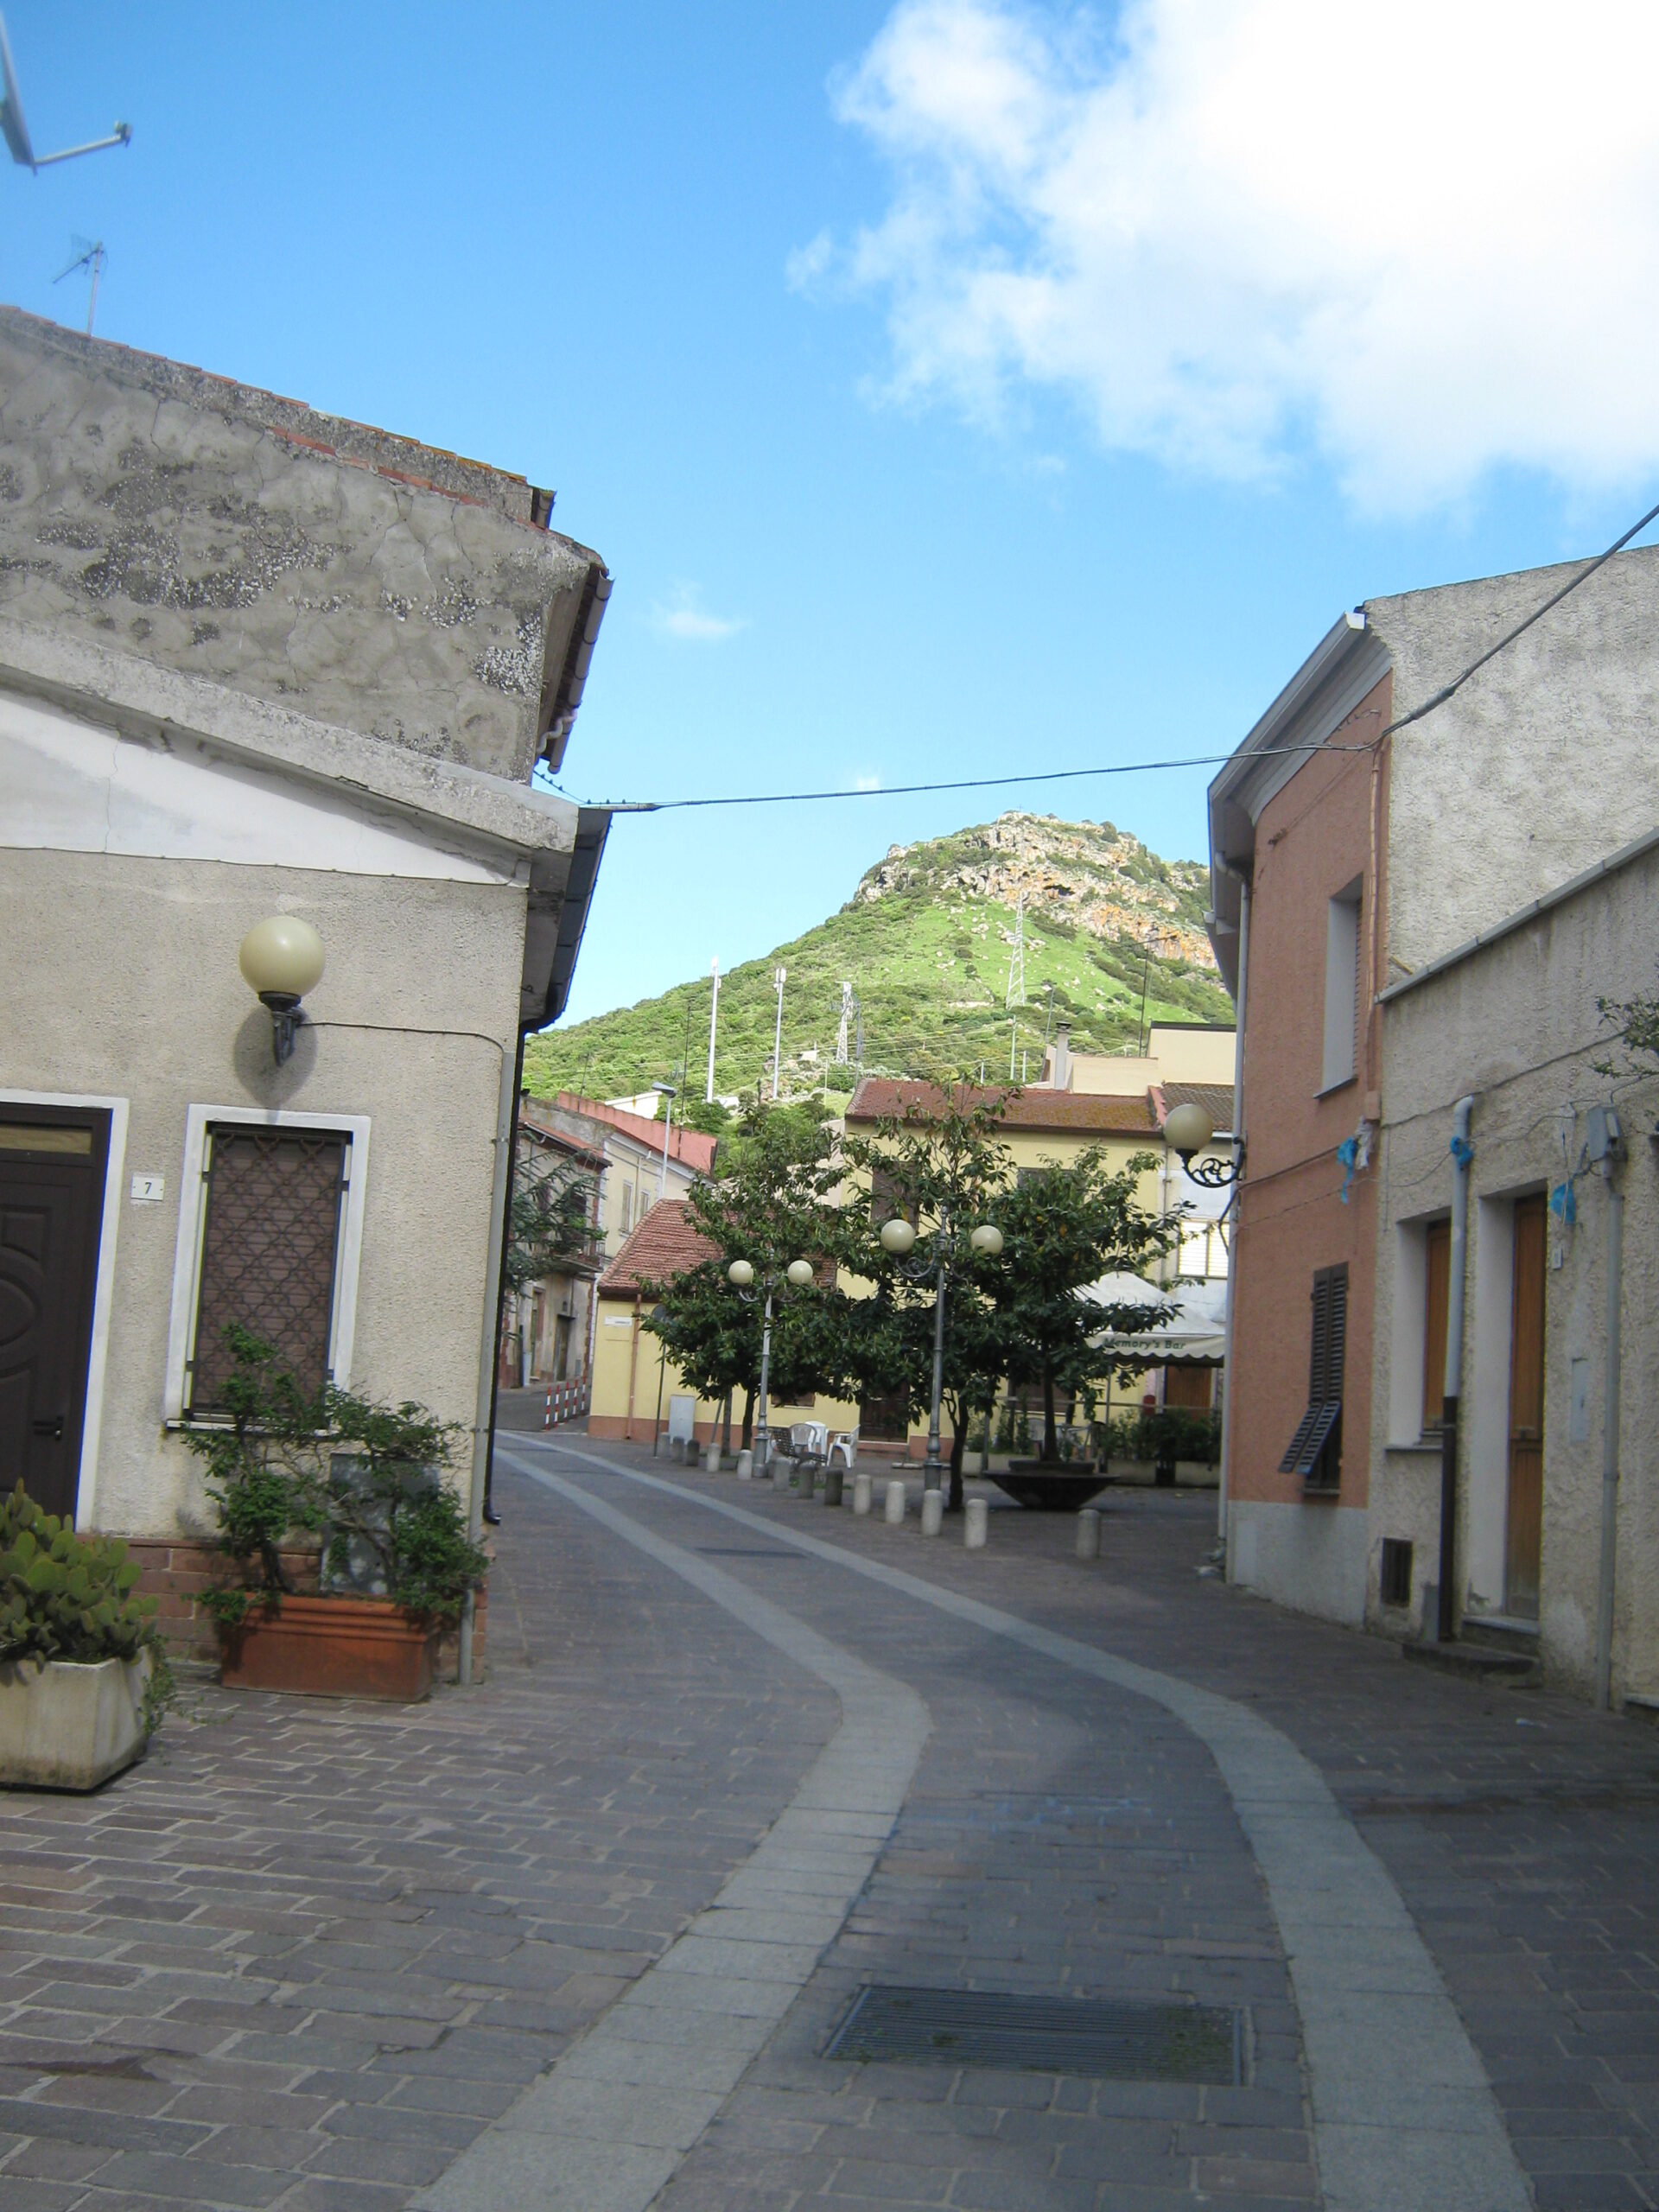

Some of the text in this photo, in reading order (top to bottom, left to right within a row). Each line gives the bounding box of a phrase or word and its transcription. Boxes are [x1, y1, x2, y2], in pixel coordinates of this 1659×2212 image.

[144, 1181, 152, 1194] 7
[1103, 1338, 1186, 1350] Memory's Bar
